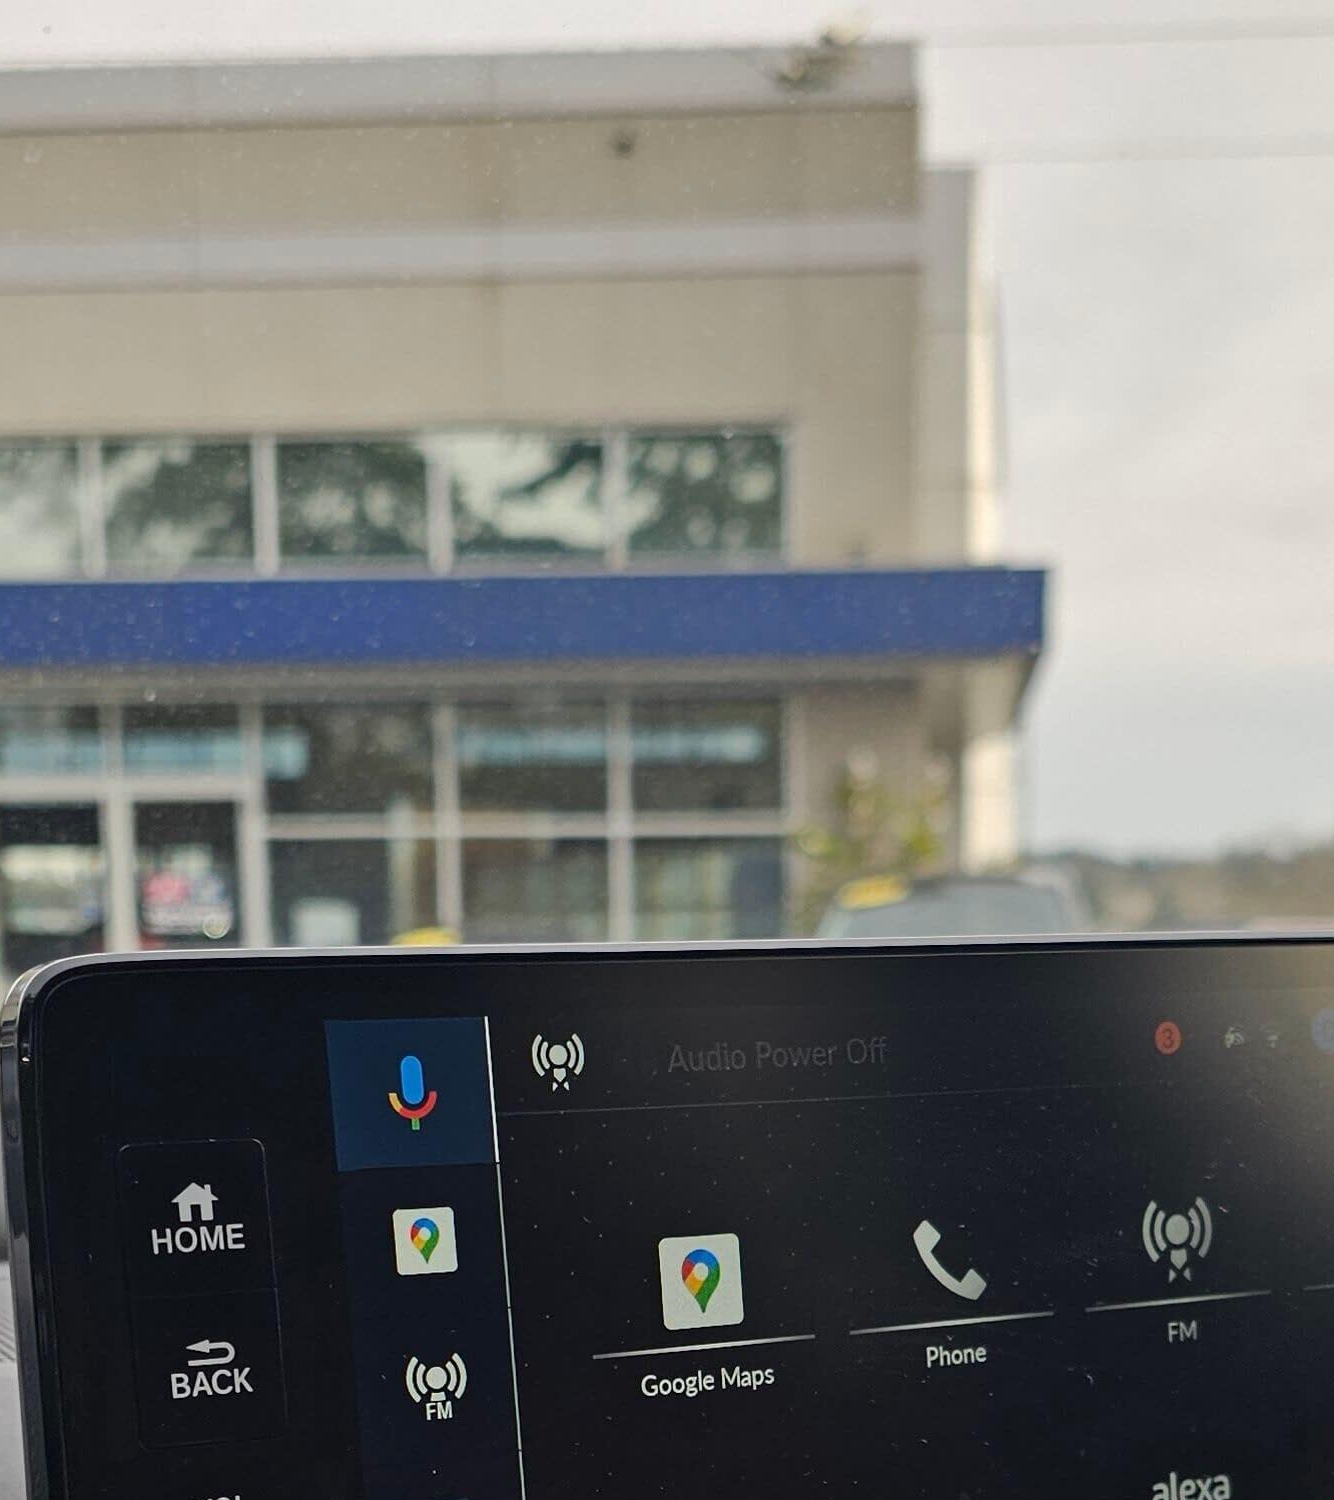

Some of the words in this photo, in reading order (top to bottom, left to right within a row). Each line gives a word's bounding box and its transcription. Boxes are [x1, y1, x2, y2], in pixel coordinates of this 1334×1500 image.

[667, 1041, 747, 1073] Audio
[754, 1037, 838, 1069] Power
[846, 1035, 887, 1065] Off
[151, 1223, 246, 1255] HOME
[1167, 1320, 1198, 1343] FM
[925, 1345, 987, 1368] Phone
[170, 1367, 254, 1399] BACK
[640, 1369, 715, 1398] Google
[720, 1365, 775, 1391] Maps
[425, 1400, 453, 1421] FM
